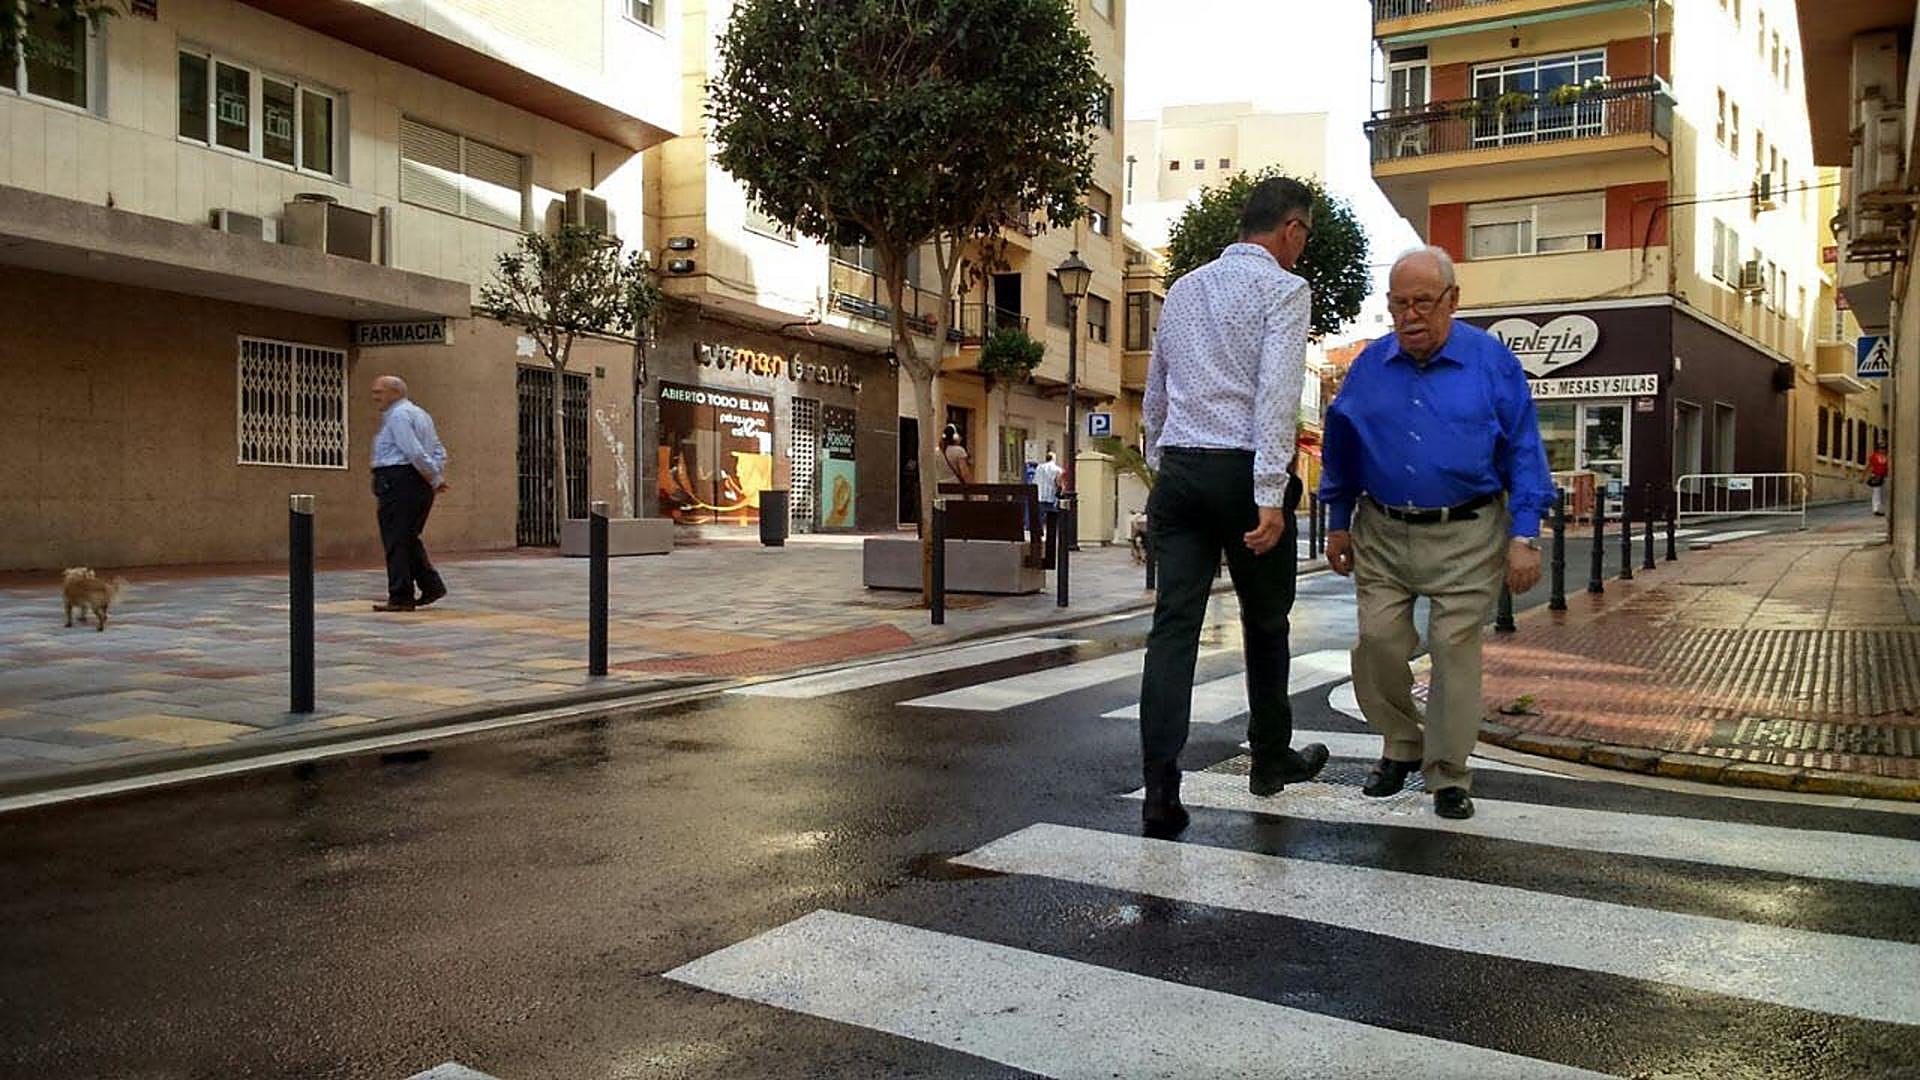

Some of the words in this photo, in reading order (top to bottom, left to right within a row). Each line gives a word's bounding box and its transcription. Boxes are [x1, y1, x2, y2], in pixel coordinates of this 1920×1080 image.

[360, 323, 442, 343] FARMACIA
[1558, 379, 1600, 395] MESAS
[1602, 379, 1611, 393] Y
[1612, 377, 1656, 393] SILLAS
[661, 387, 706, 404] ABIERTO
[707, 393, 738, 408] TODO
[739, 398, 751, 410] EL
[752, 400, 770, 413] DIA
[1092, 415, 1107, 434] P
